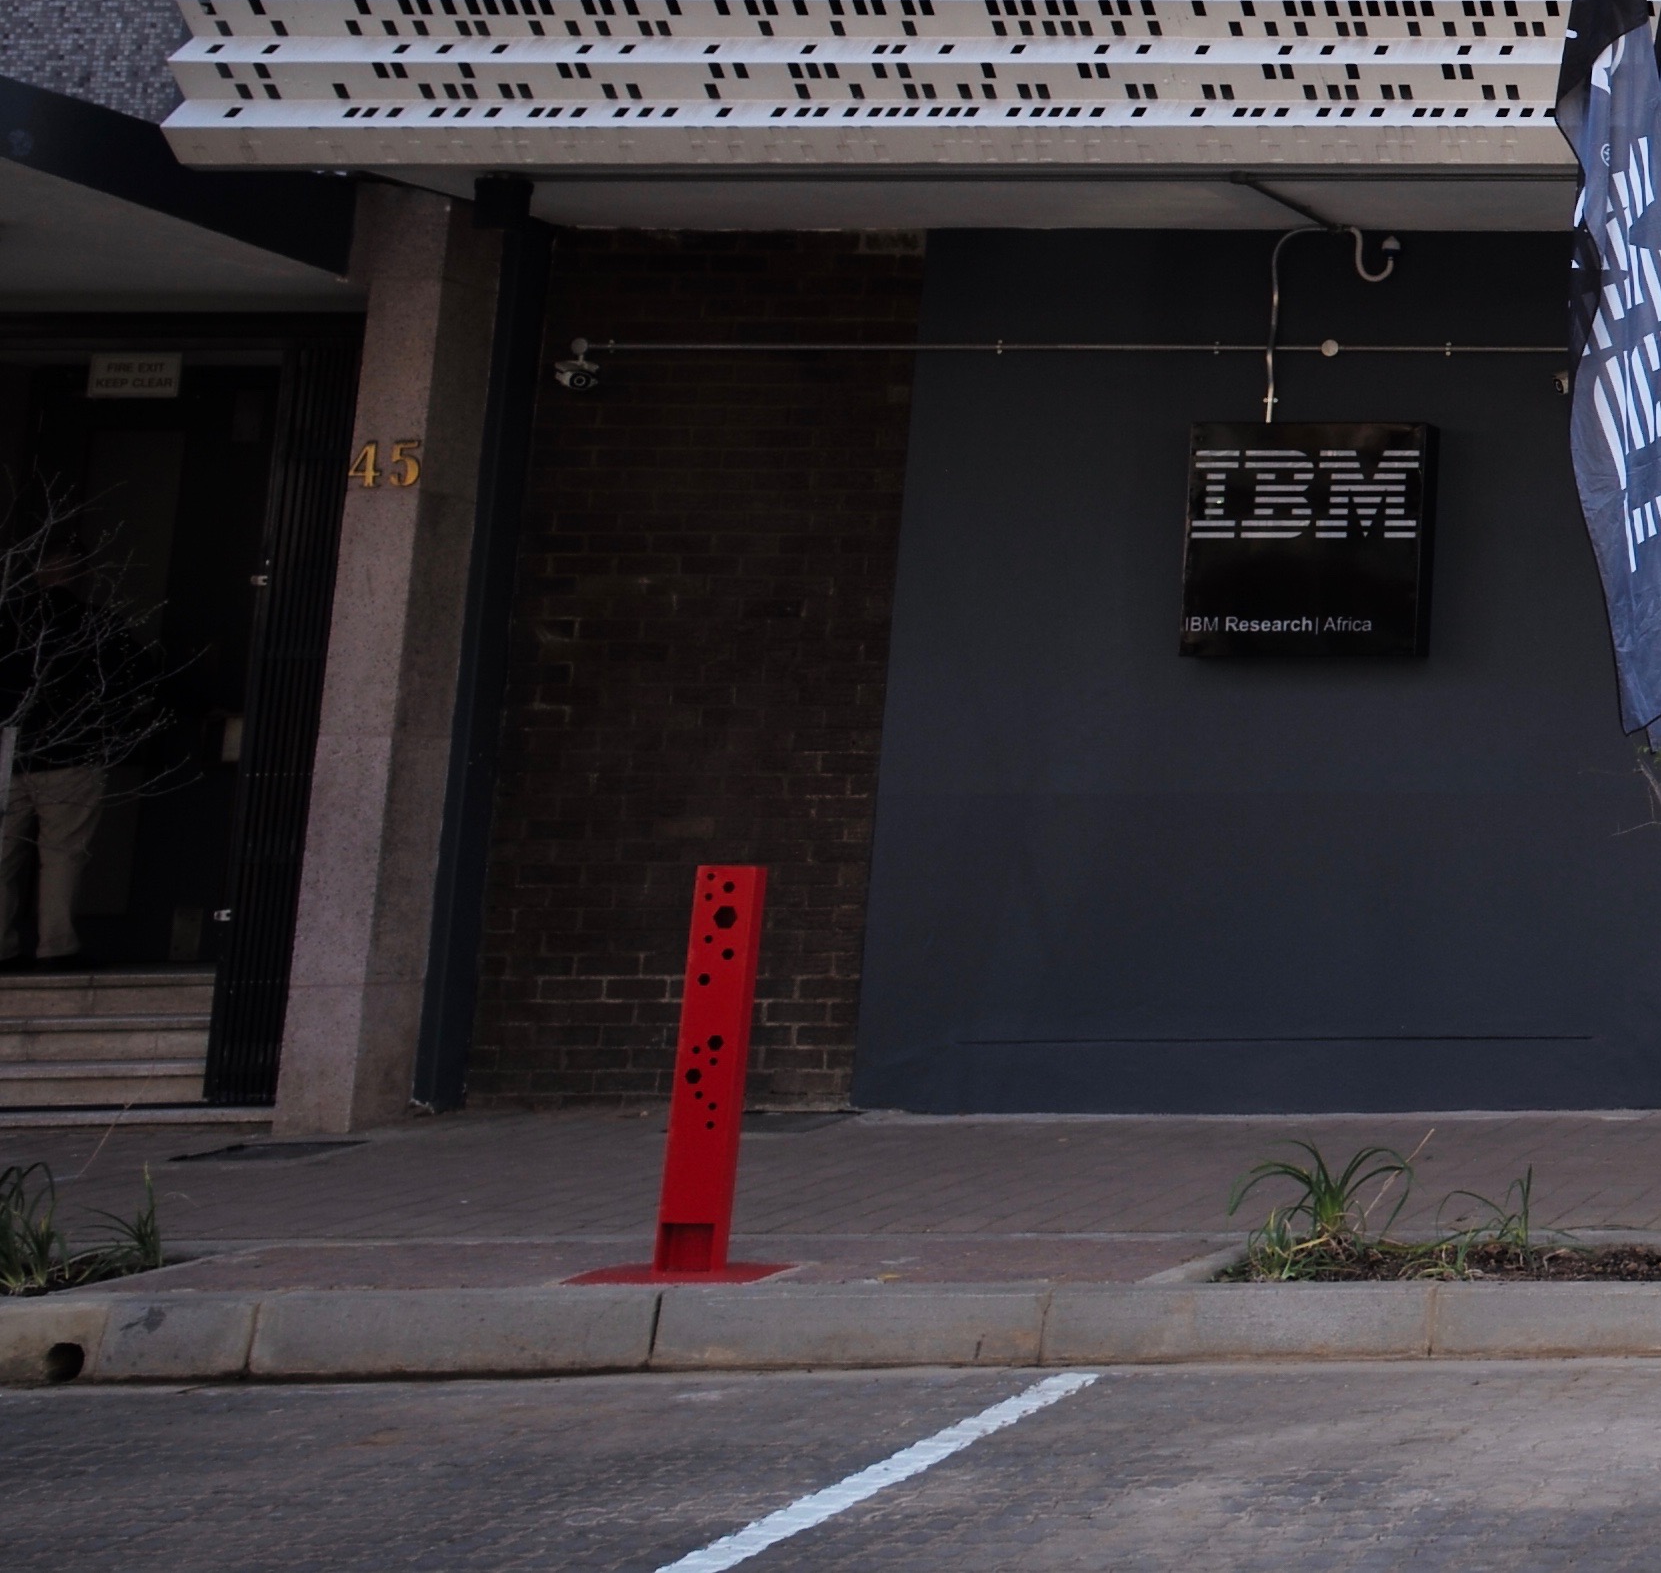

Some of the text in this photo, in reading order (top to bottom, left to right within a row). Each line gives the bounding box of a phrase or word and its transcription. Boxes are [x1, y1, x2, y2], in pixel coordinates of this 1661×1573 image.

[107, 362, 165, 373] FIRE EXIT
[96, 378, 172, 388] KEEP CLEAR
[348, 440, 421, 488] 45
[1190, 449, 1420, 538] IBM
[1185, 616, 1219, 632] IBM
[1225, 616, 1313, 632] Research
[1323, 616, 1372, 632] Africa
